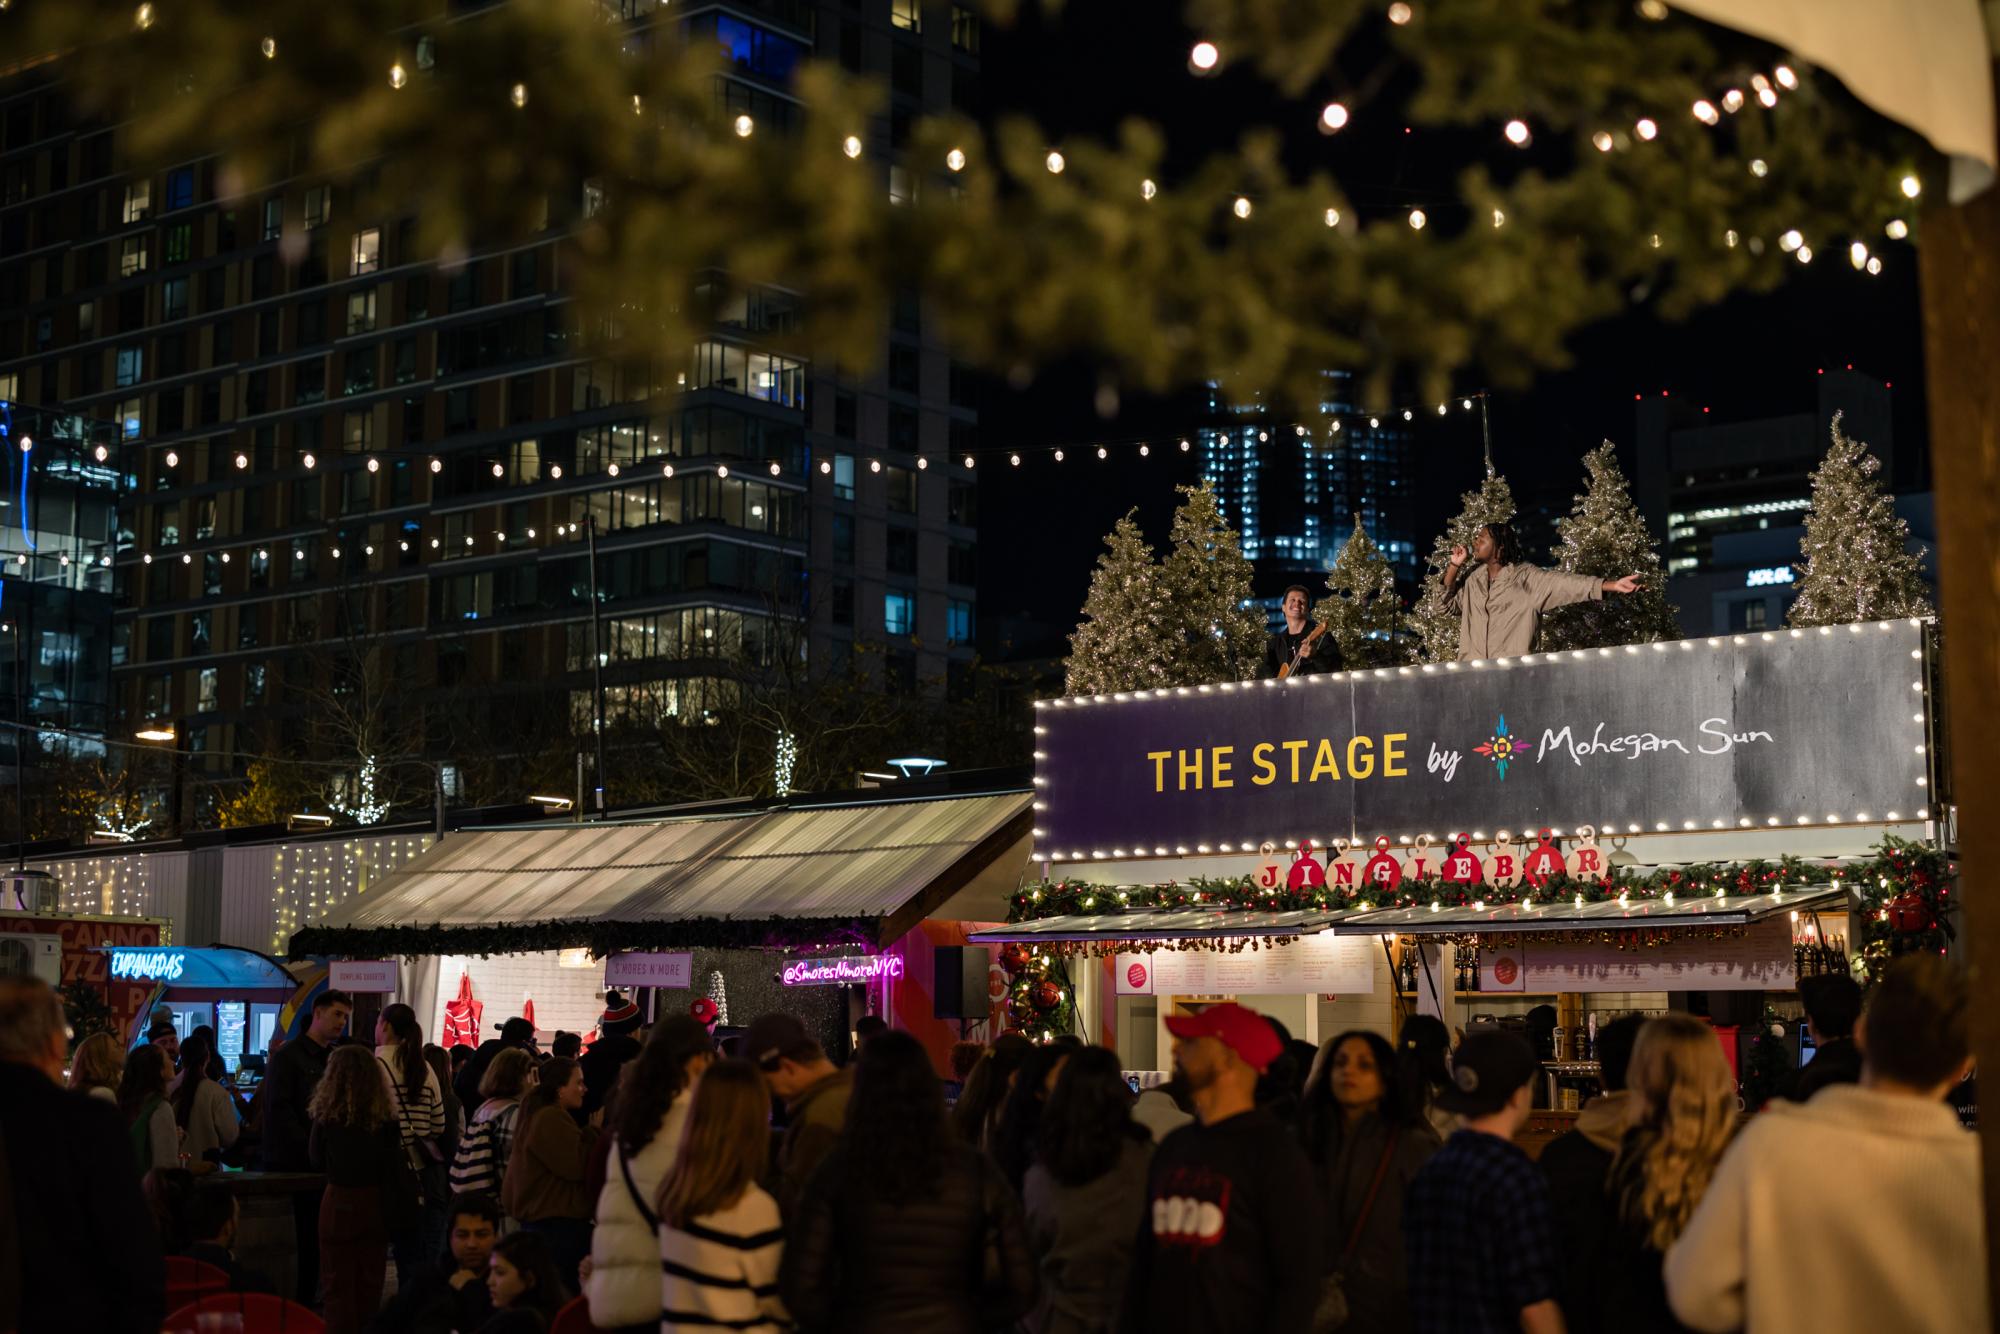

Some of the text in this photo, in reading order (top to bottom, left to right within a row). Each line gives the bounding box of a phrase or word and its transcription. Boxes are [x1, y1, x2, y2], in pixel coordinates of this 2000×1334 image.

[1147, 717, 1774, 792] THE STAGE by Mohegan Sun
[112, 952, 185, 980] EMPANADAS
[614, 962, 647, 975] S'MORES
